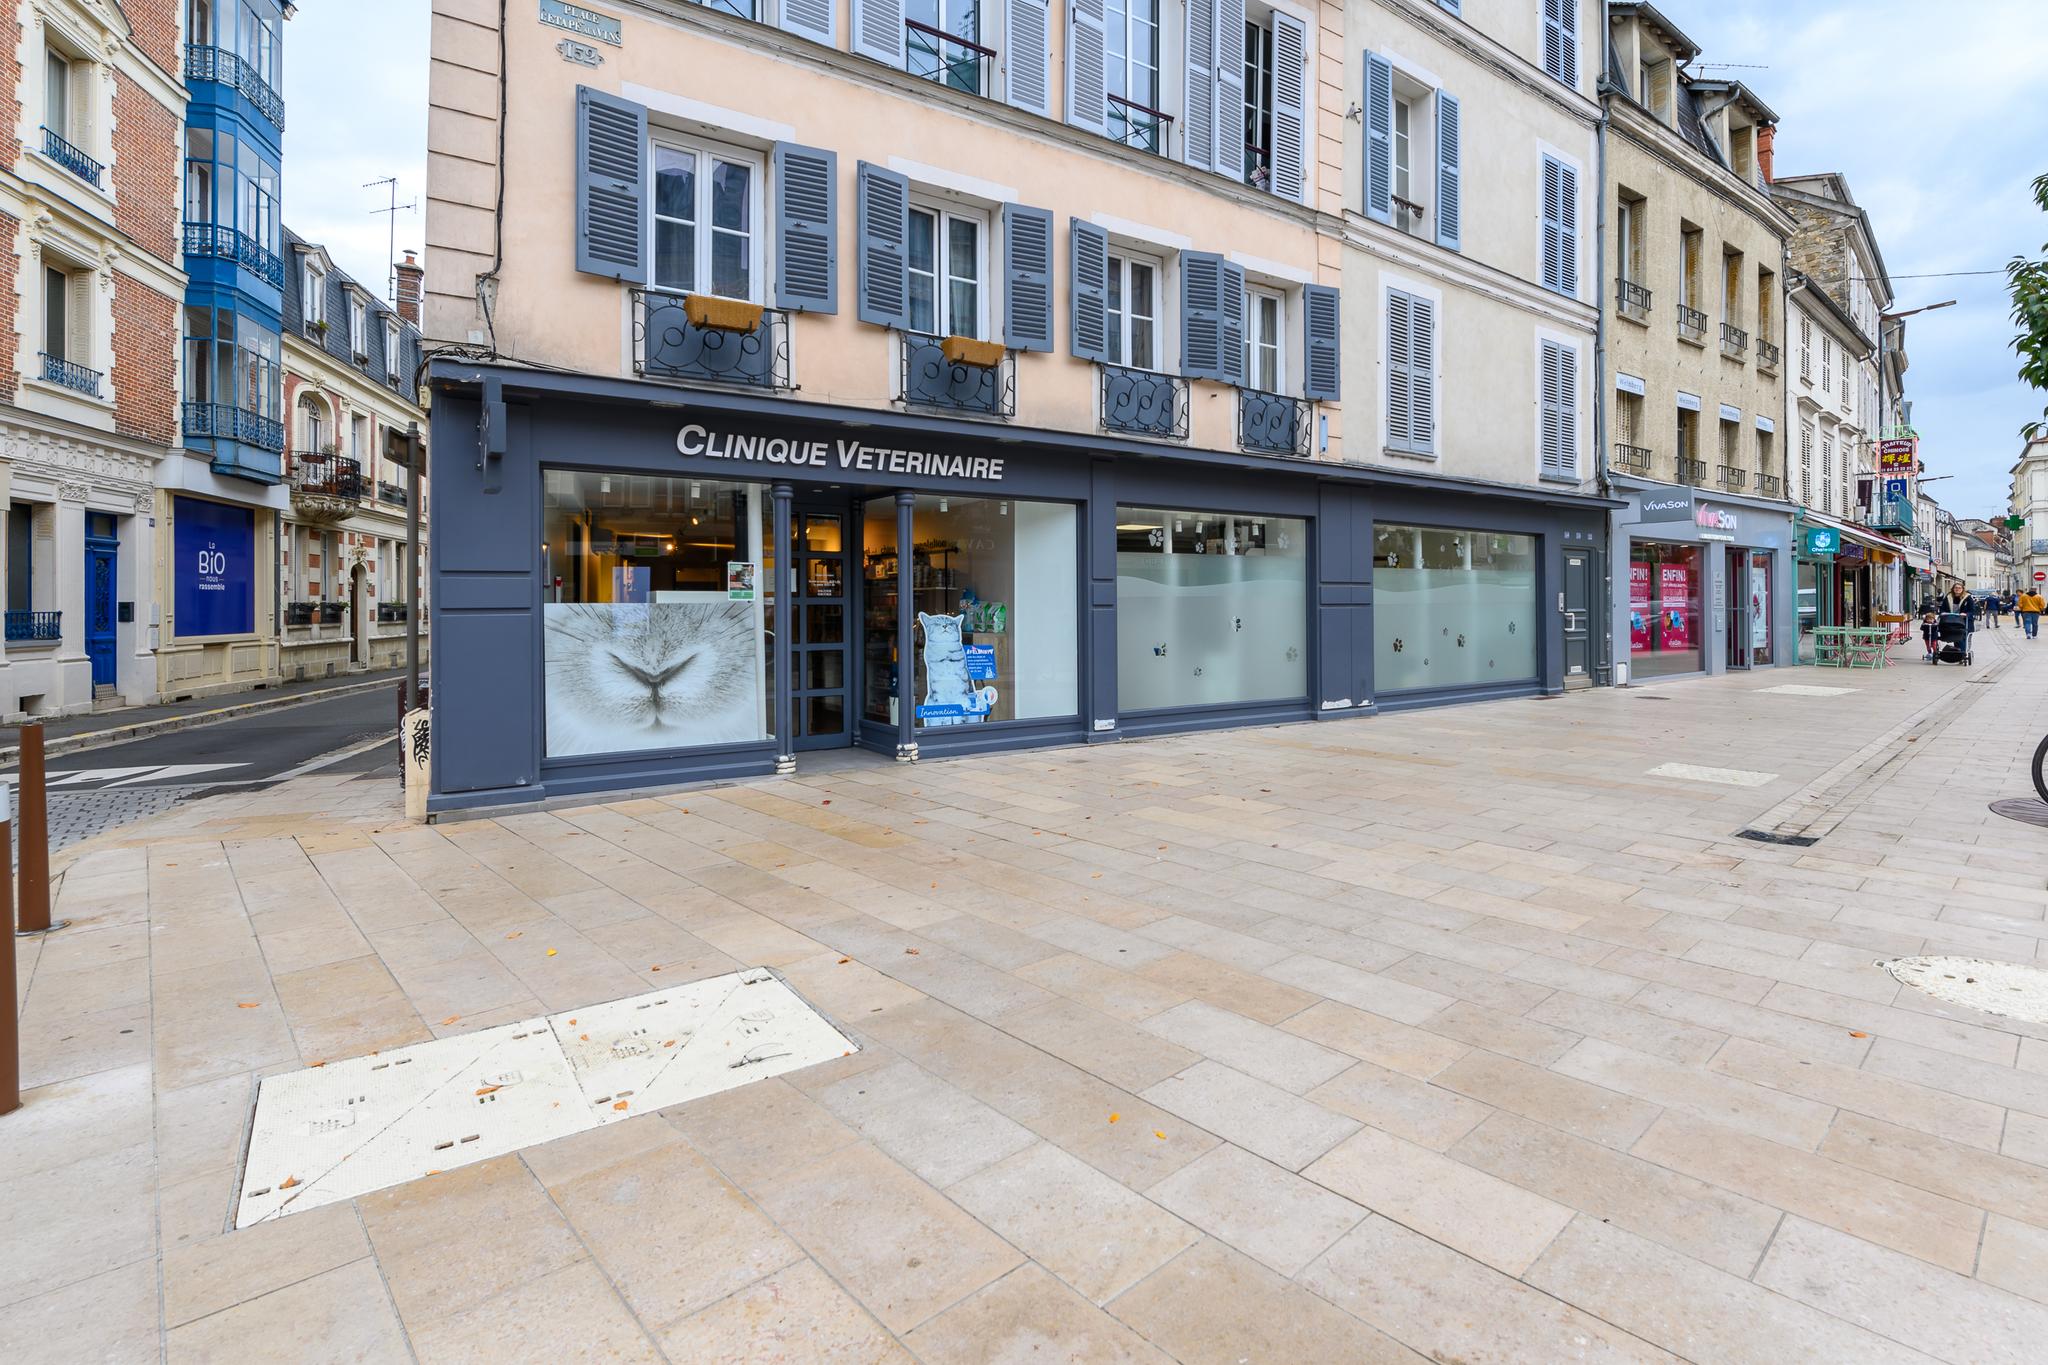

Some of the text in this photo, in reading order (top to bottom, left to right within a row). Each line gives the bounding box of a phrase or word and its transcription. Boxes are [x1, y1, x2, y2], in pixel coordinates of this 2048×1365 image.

[564, 5, 599, 24] PLACE
[597, 27, 621, 43] VINS
[676, 424, 1004, 480] CLINIQUE VETERINAIRE
[1881, 441, 1912, 450] TRAITEUR
[1662, 568, 1686, 582] ENFIN!
